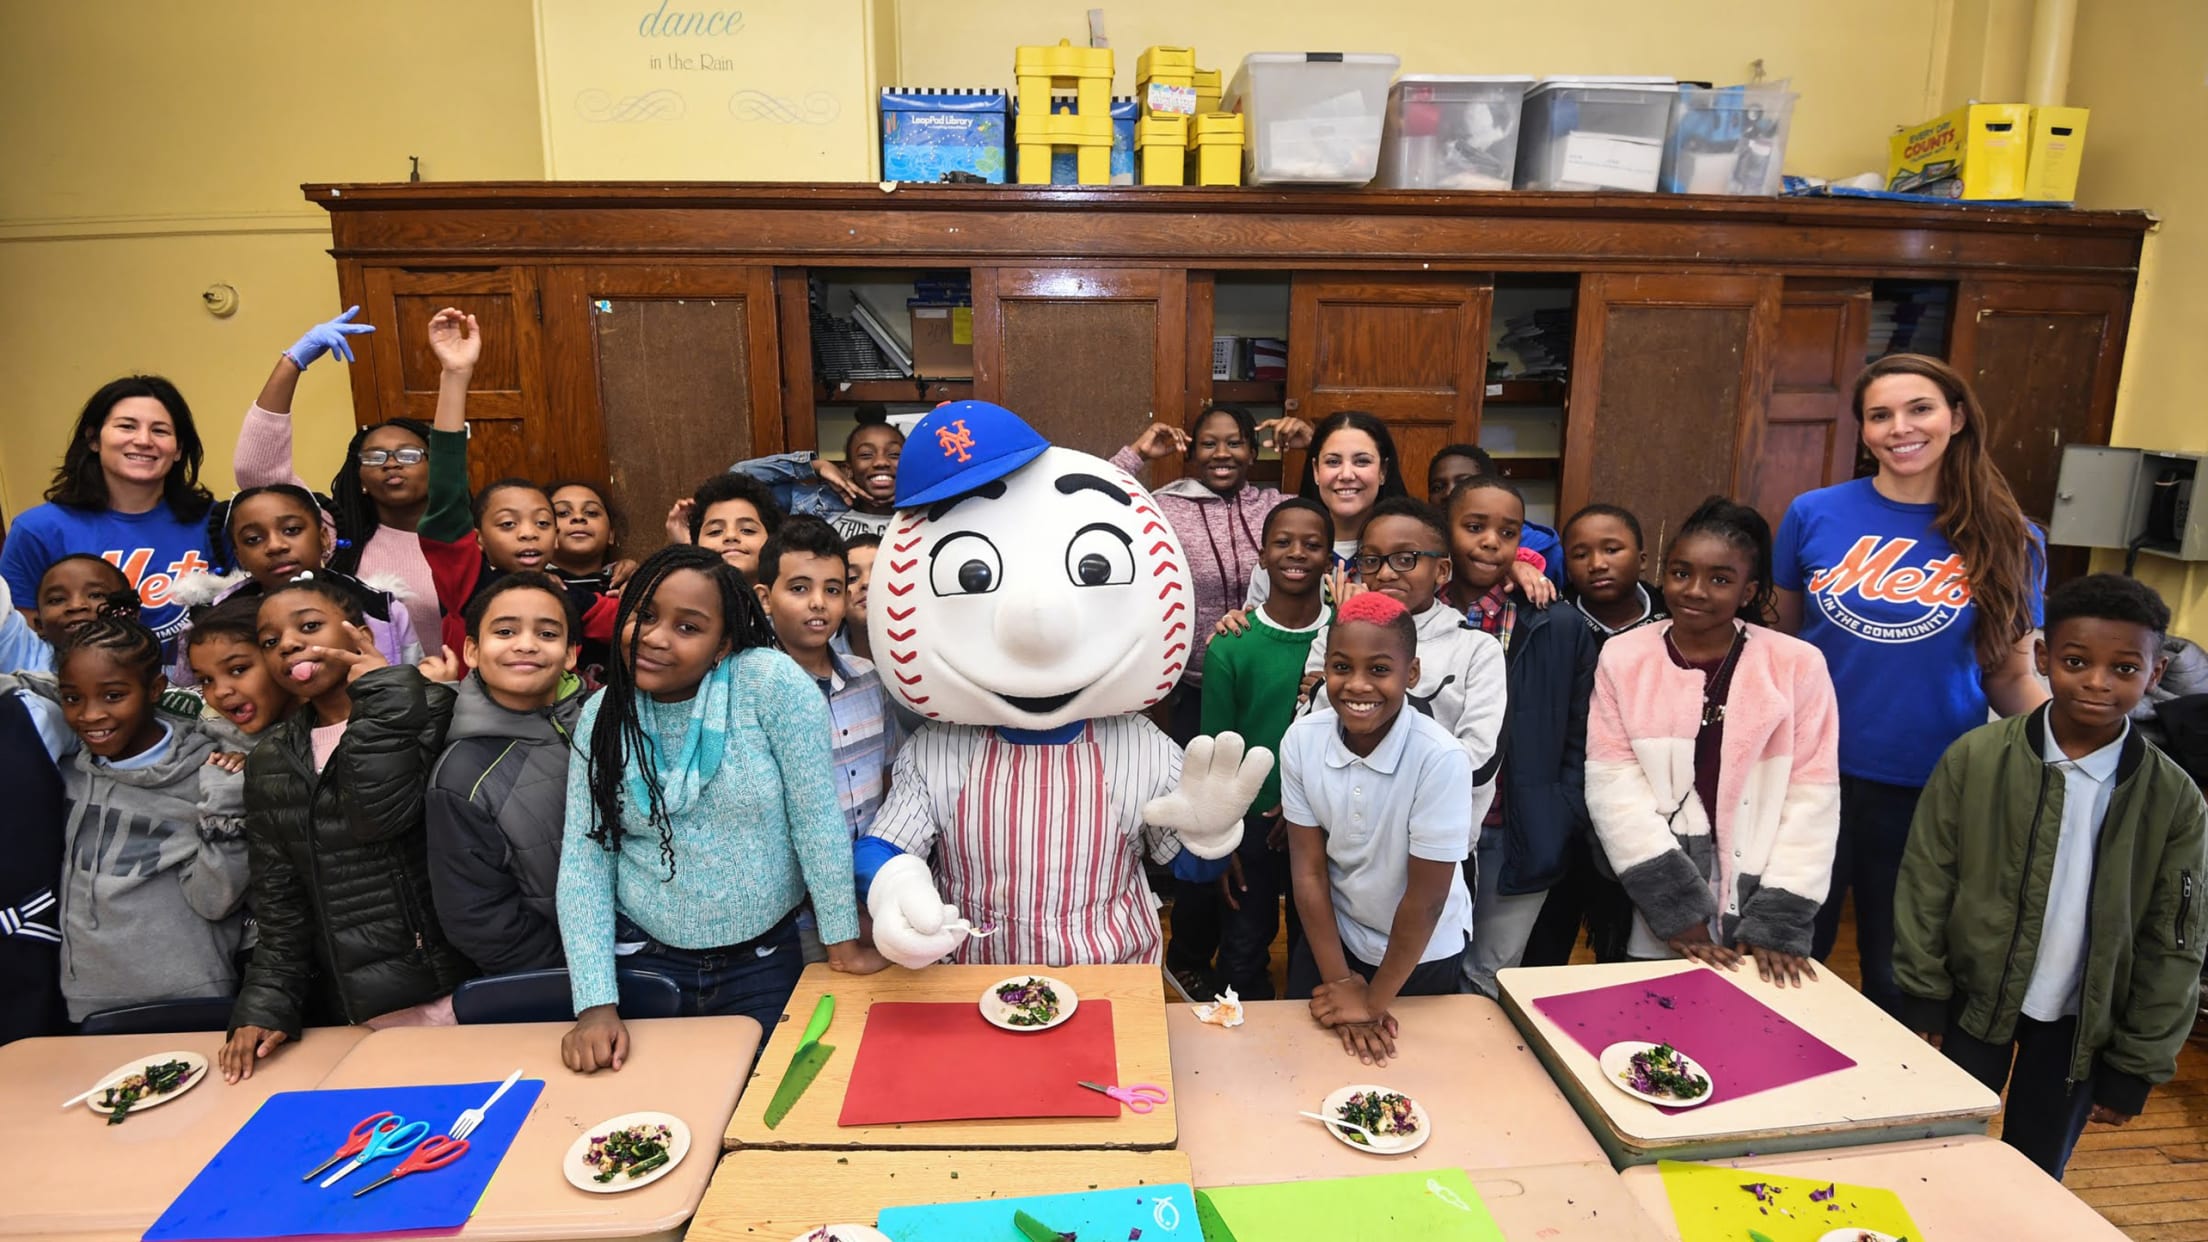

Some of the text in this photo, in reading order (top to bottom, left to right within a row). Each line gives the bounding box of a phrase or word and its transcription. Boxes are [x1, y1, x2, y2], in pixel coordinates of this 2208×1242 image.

[638, 0, 745, 37] dance
[649, 52, 734, 71] in the Rain
[911, 115, 974, 128] LeapPad Library
[1904, 128, 1956, 160] COUNTS
[840, 521, 869, 538] THIS
[1808, 535, 1975, 609] Mets
[1823, 598, 1949, 639] IN THE COMMUNITY
